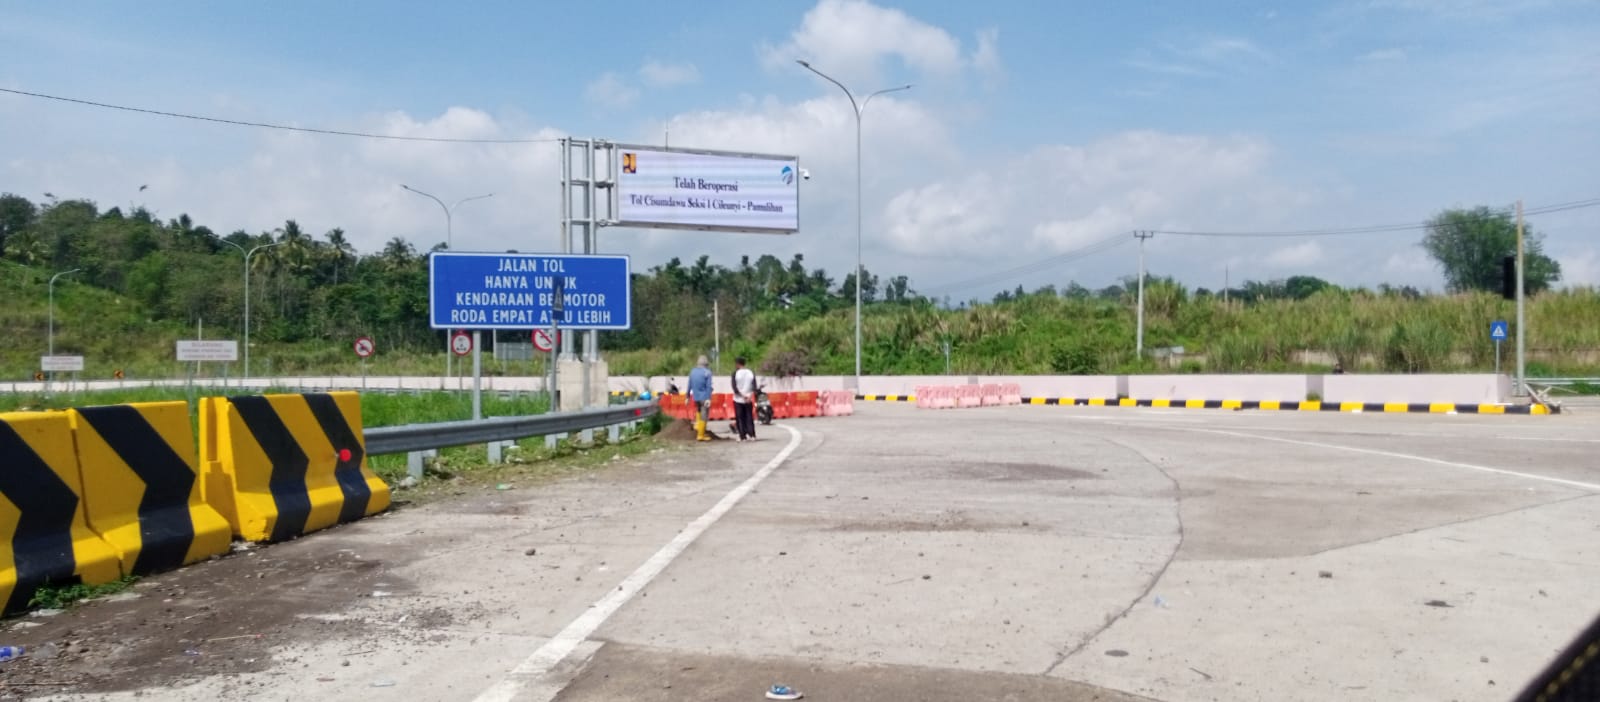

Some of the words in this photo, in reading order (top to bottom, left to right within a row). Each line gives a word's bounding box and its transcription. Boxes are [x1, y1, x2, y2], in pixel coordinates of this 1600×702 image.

[673, 176, 696, 190] Telah
[697, 178, 739, 193] Beroperasi
[629, 193, 643, 205] Tol
[644, 195, 686, 208] Cisumdawu
[687, 197, 706, 209] Seksi
[712, 199, 741, 213] Cileunyi
[747, 201, 783, 212] Pamulihan
[497, 258, 537, 272] JALAN
[542, 259, 566, 273] TOL
[485, 275, 528, 289] HANYA
[534, 276, 577, 289] UNUK
[456, 292, 534, 306] KENDARAAN
[539, 293, 606, 307] BEMOTOR
[451, 309, 487, 323] RODA
[493, 310, 533, 323] EMPAT
[540, 310, 573, 323] ATU
[577, 310, 611, 324] LEBIH
